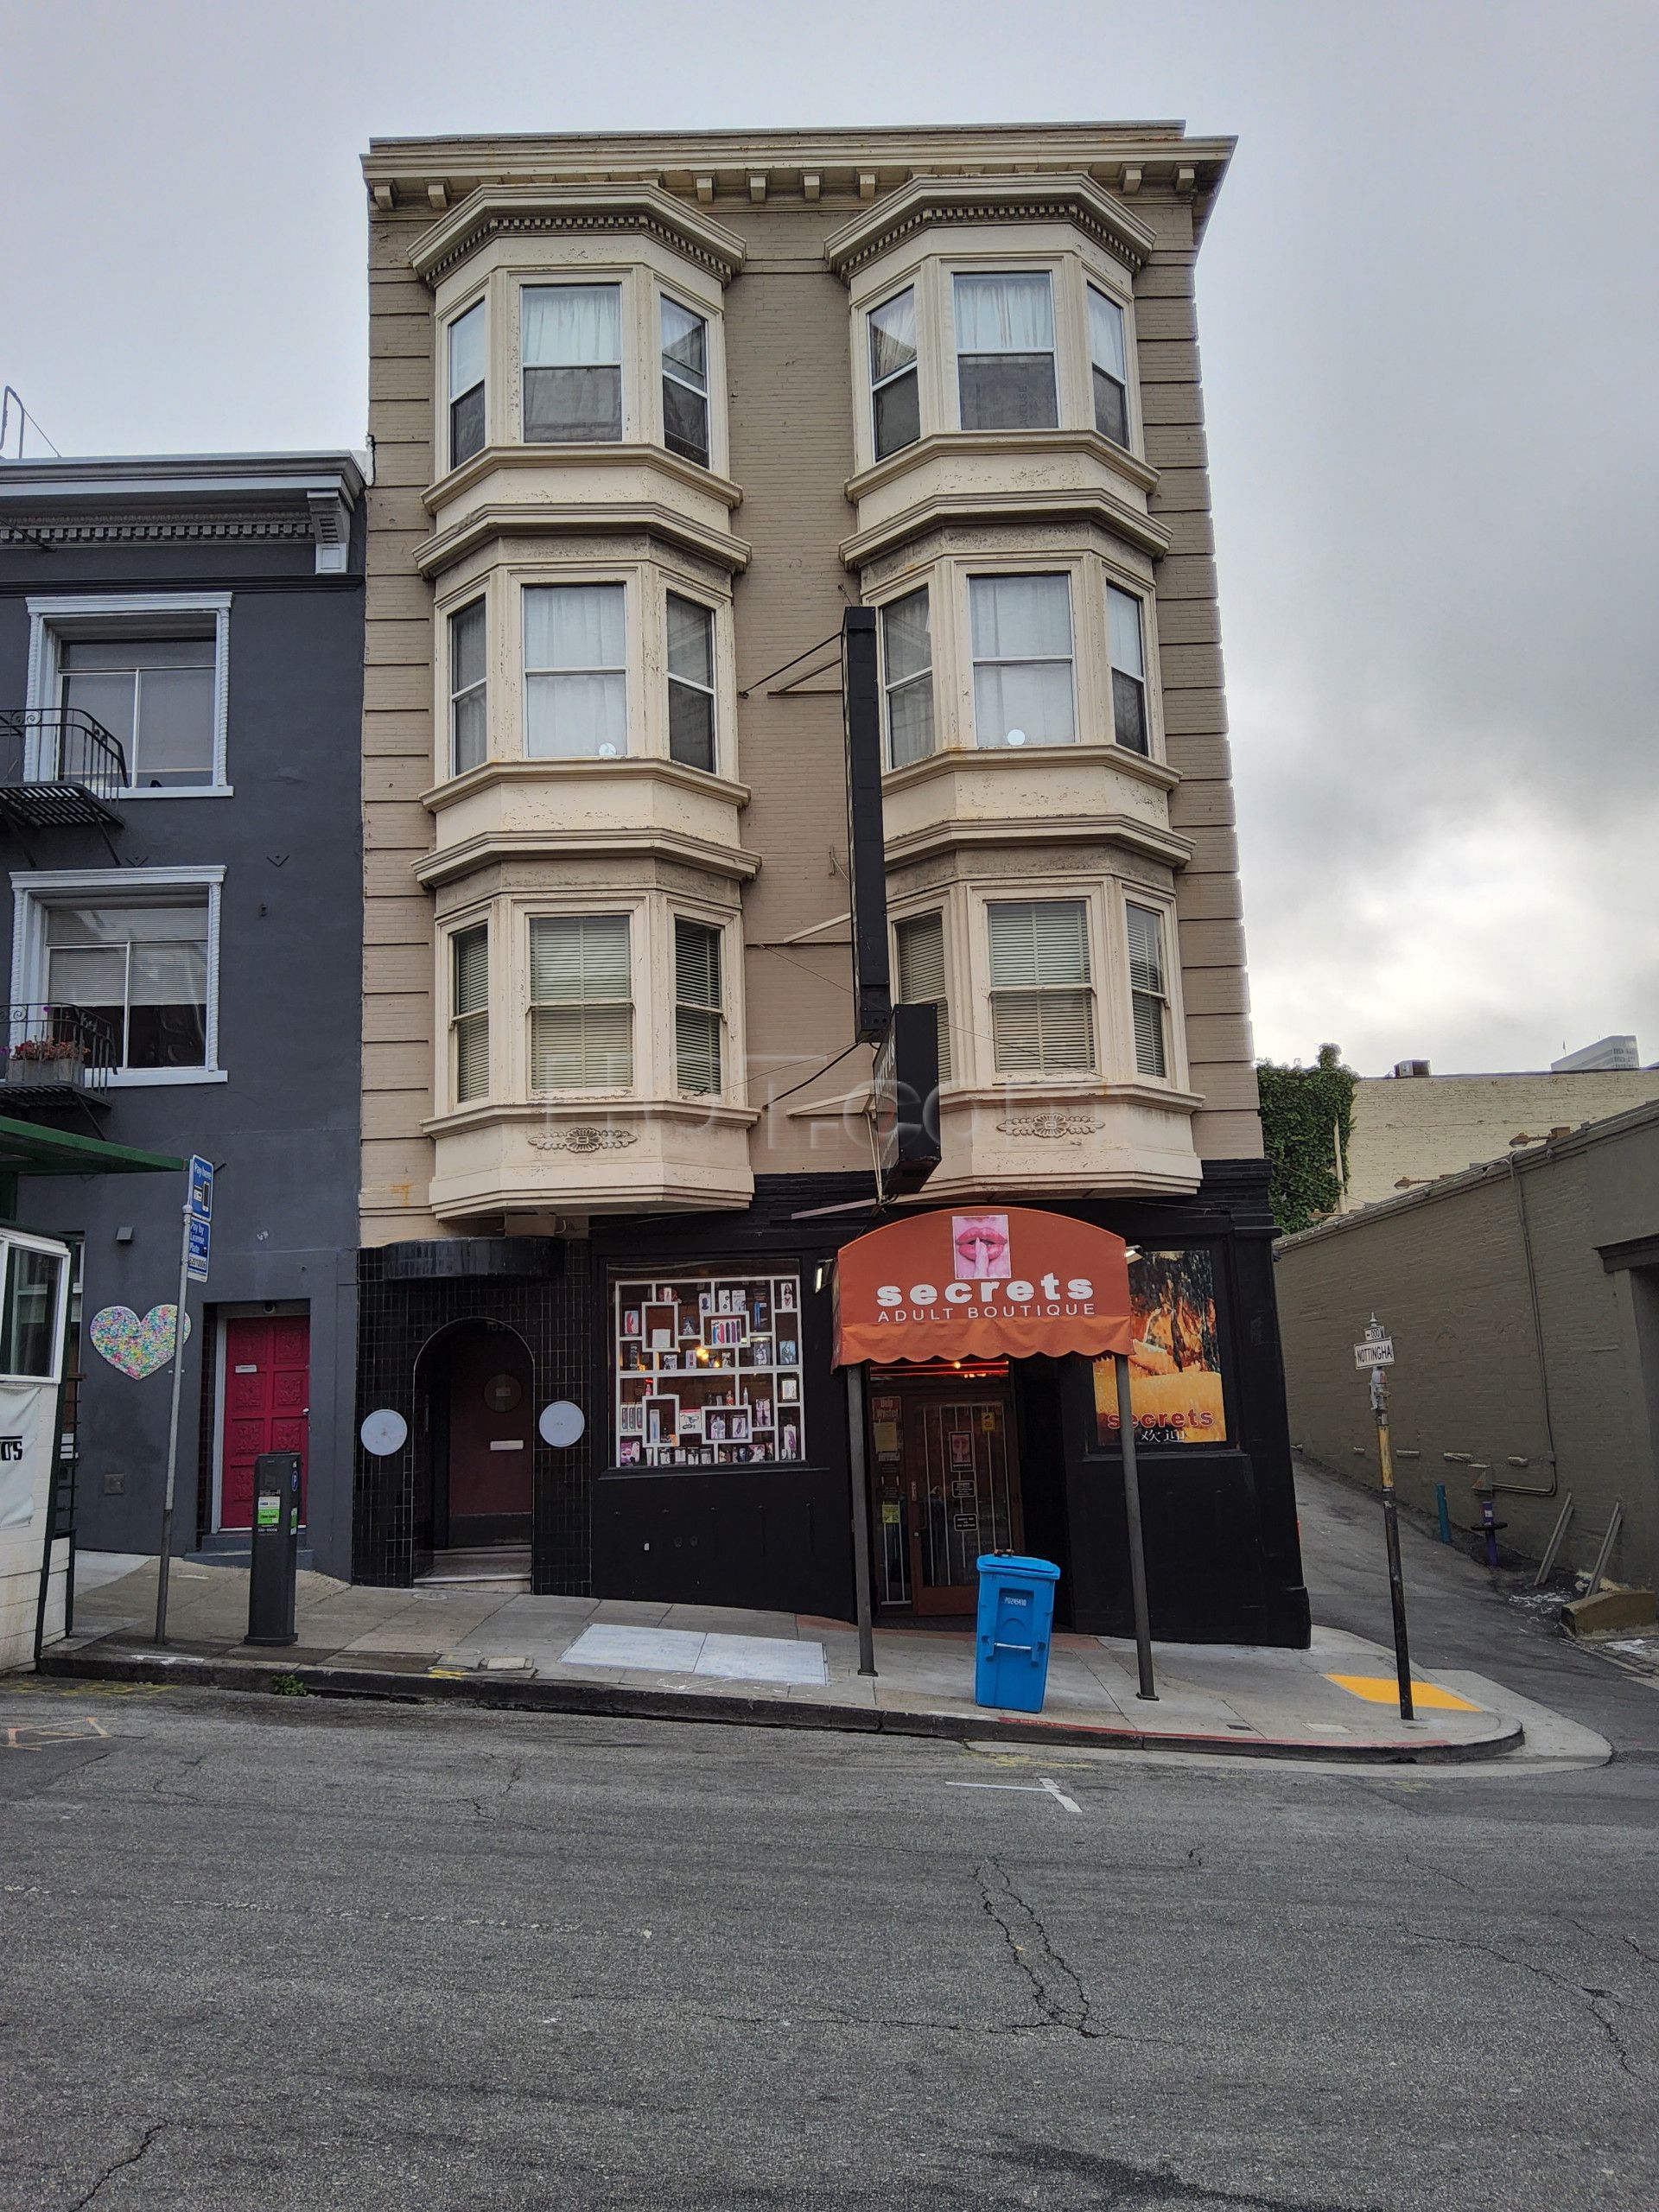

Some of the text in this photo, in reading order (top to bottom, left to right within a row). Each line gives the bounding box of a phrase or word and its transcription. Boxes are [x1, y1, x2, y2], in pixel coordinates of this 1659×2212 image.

[876, 1272, 1094, 1306] secrets
[878, 1303, 1095, 1322] ADULT BOUTIQUE
[1141, 1429, 1185, 1443] 欢迎
